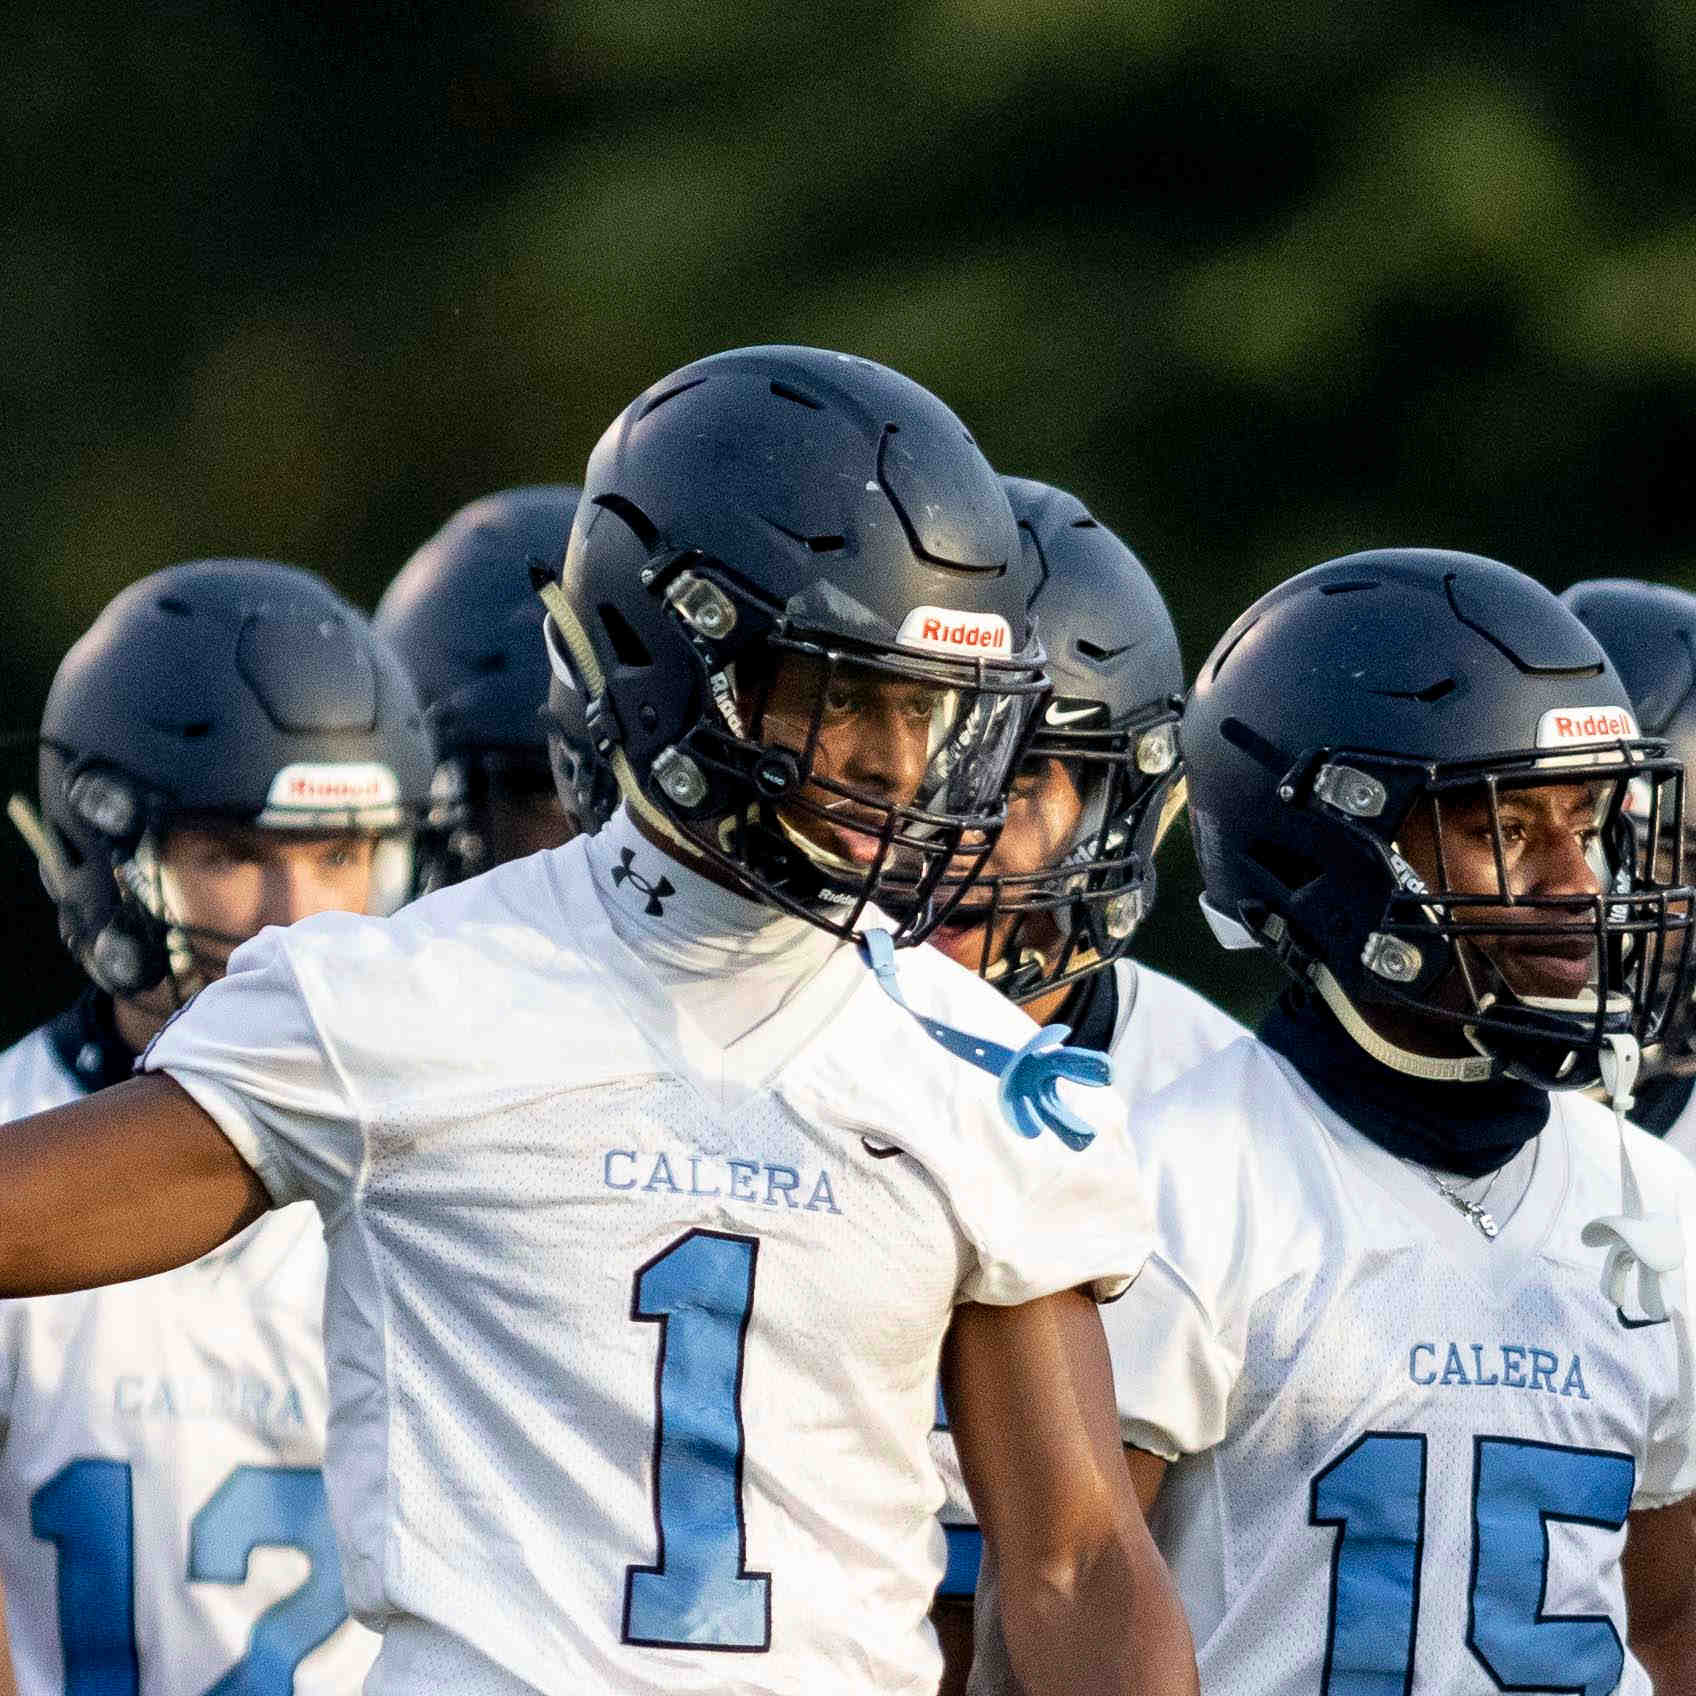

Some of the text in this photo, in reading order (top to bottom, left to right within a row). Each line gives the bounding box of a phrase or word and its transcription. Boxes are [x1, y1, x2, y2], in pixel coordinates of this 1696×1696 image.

[922, 618, 1005, 648] Riddell
[1554, 713, 1632, 737] Riddell
[603, 1147, 842, 1215] CALERA
[1408, 1341, 1591, 1401] CALERA
[620, 1227, 772, 1652] 1
